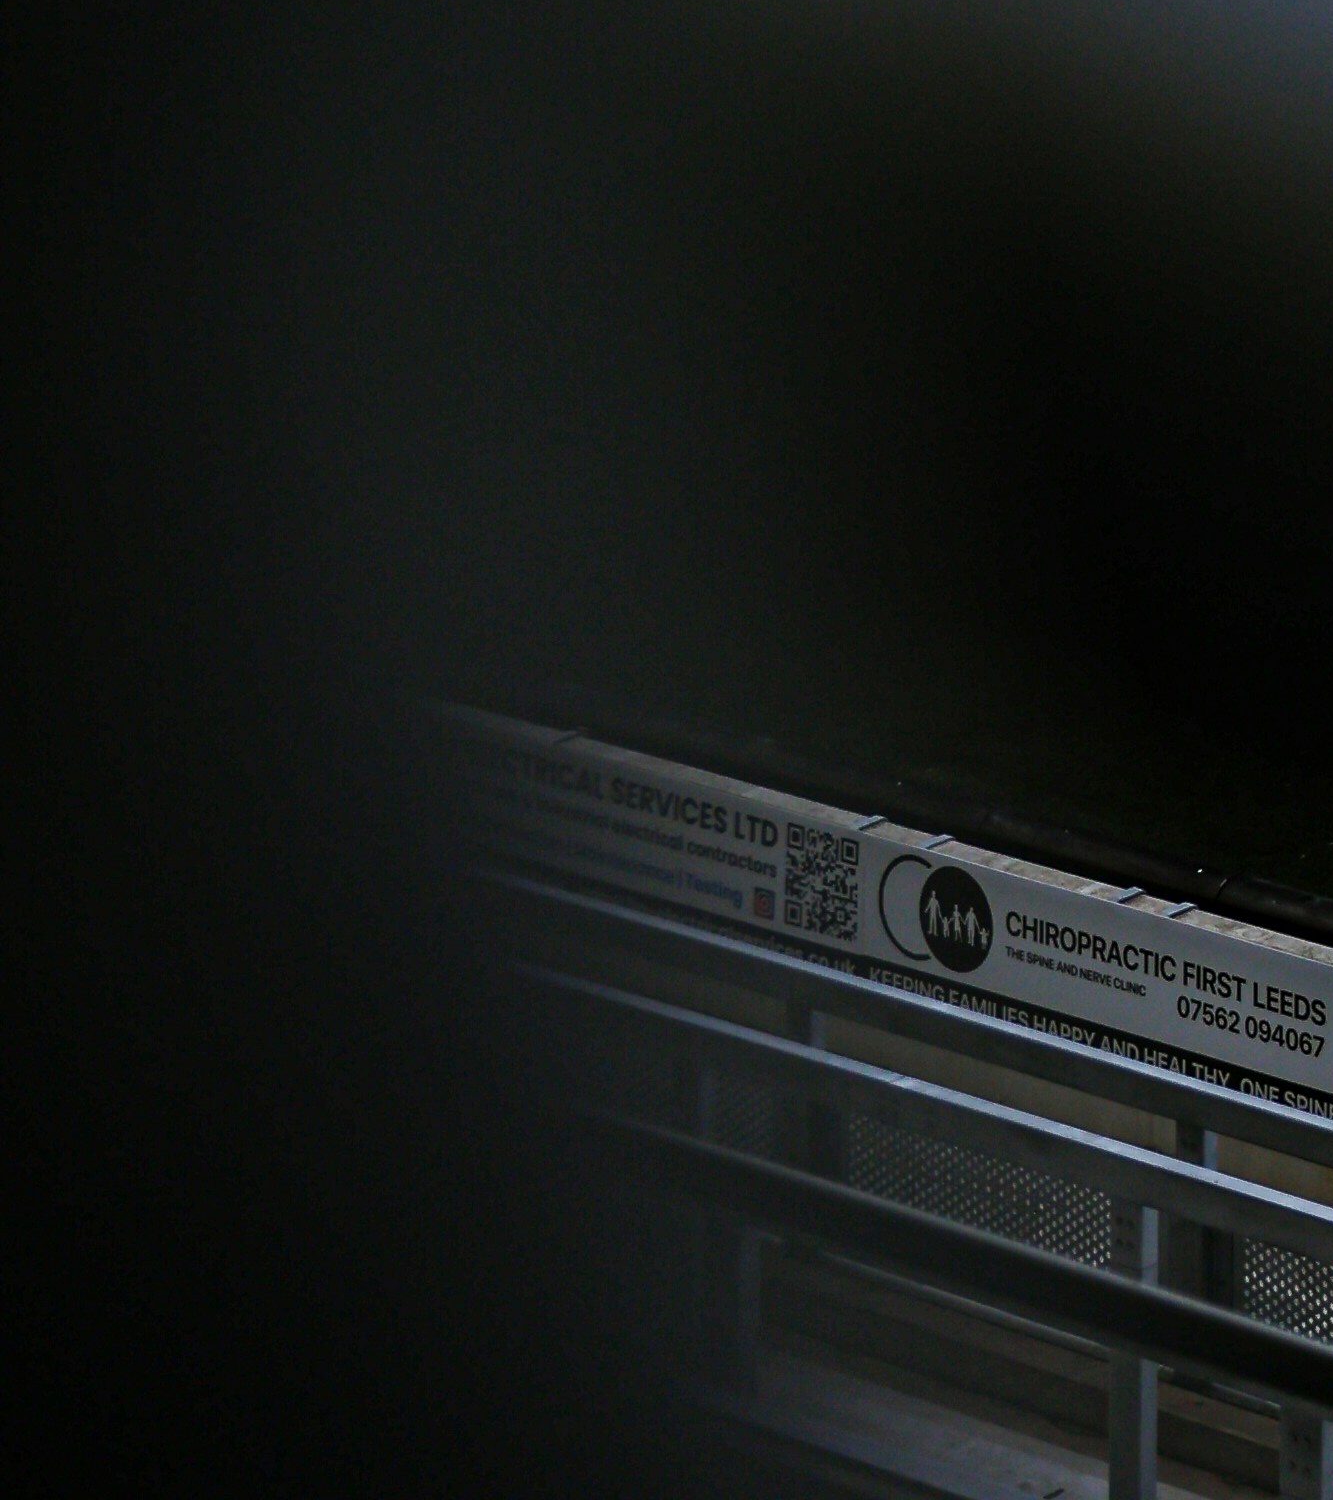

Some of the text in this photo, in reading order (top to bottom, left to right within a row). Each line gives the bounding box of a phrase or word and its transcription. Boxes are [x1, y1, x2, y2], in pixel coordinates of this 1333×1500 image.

[612, 777, 727, 834] SERVICES
[735, 811, 778, 847] LTD
[687, 841, 777, 879] contractors
[1005, 910, 1327, 1027] CHIROPRACTIC FIRST LEEDS
[1006, 946, 1147, 998] THE SPINE AND NERVE CLINIC
[1176, 994, 1326, 1059] 07562 094067
